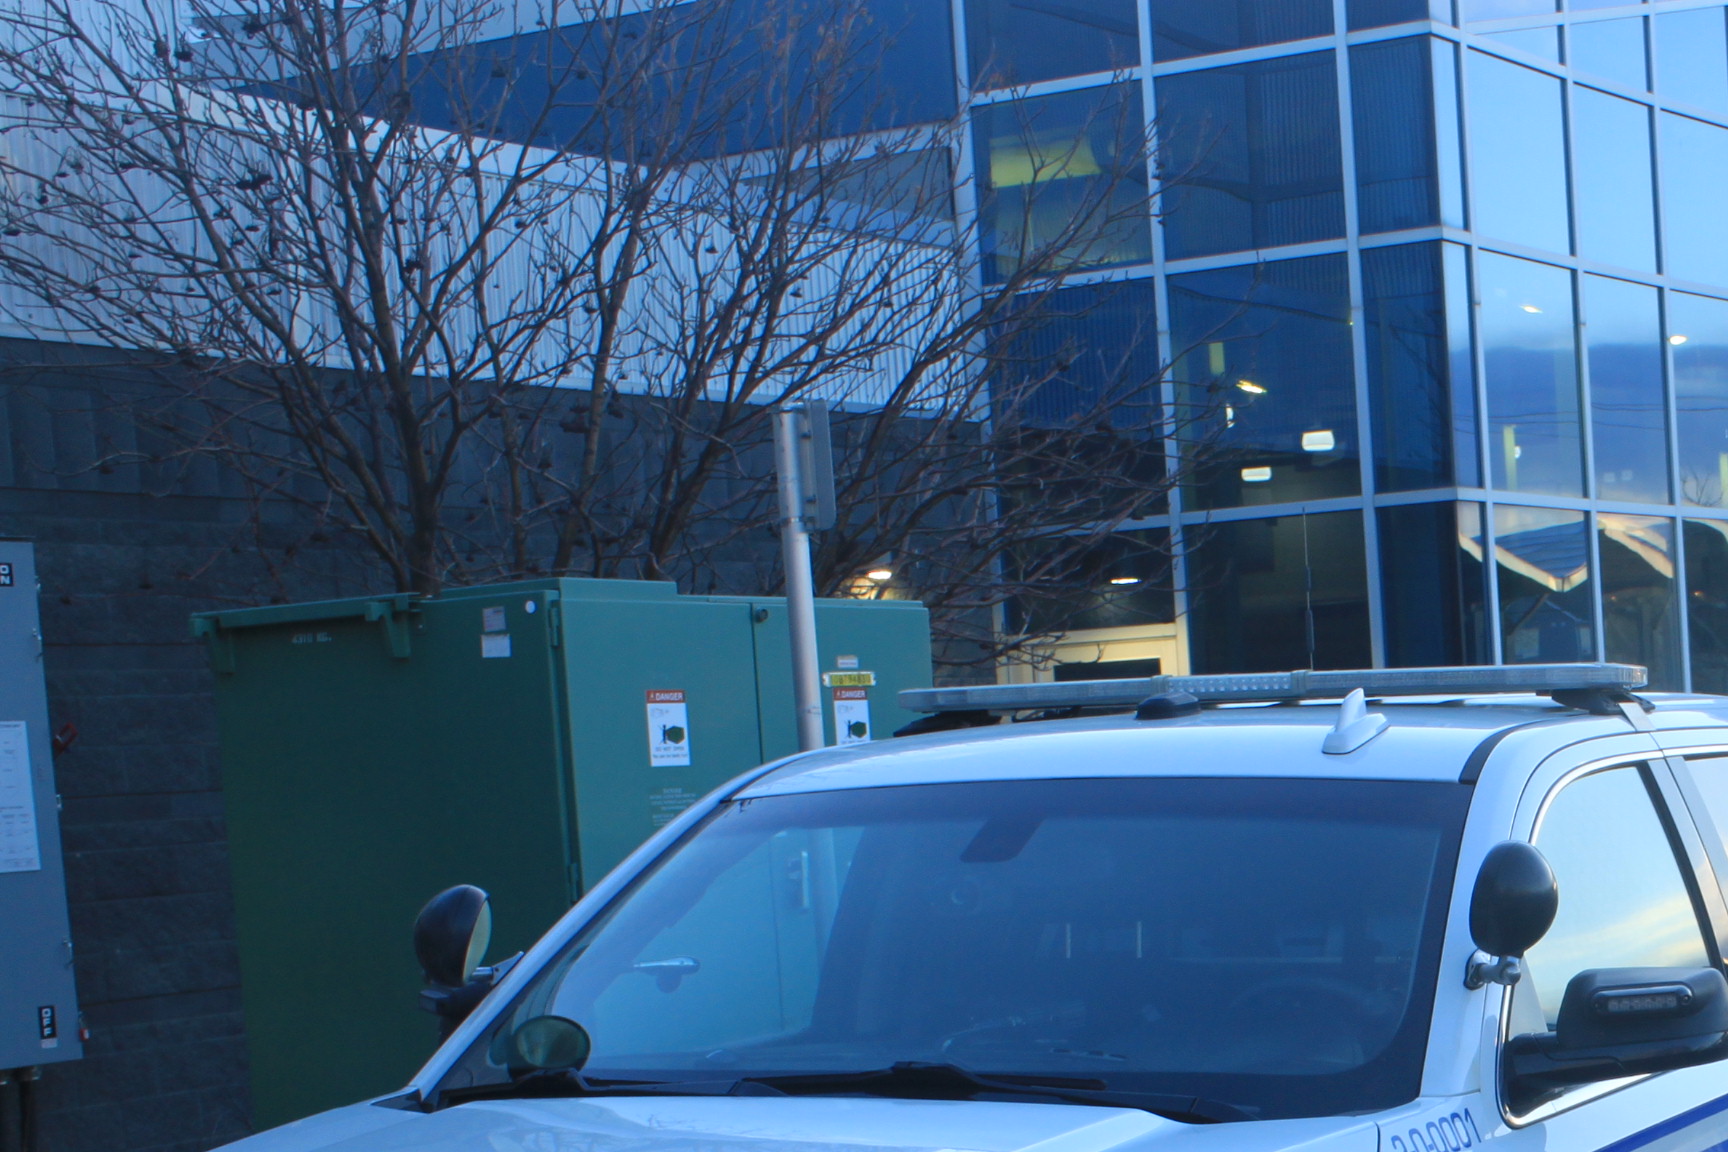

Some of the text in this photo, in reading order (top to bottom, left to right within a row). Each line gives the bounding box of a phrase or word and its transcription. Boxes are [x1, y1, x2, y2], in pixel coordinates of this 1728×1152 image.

[655, 692, 683, 701] DANGER
[841, 690, 866, 698] DANGER
[41, 1008, 52, 1037] OFF
